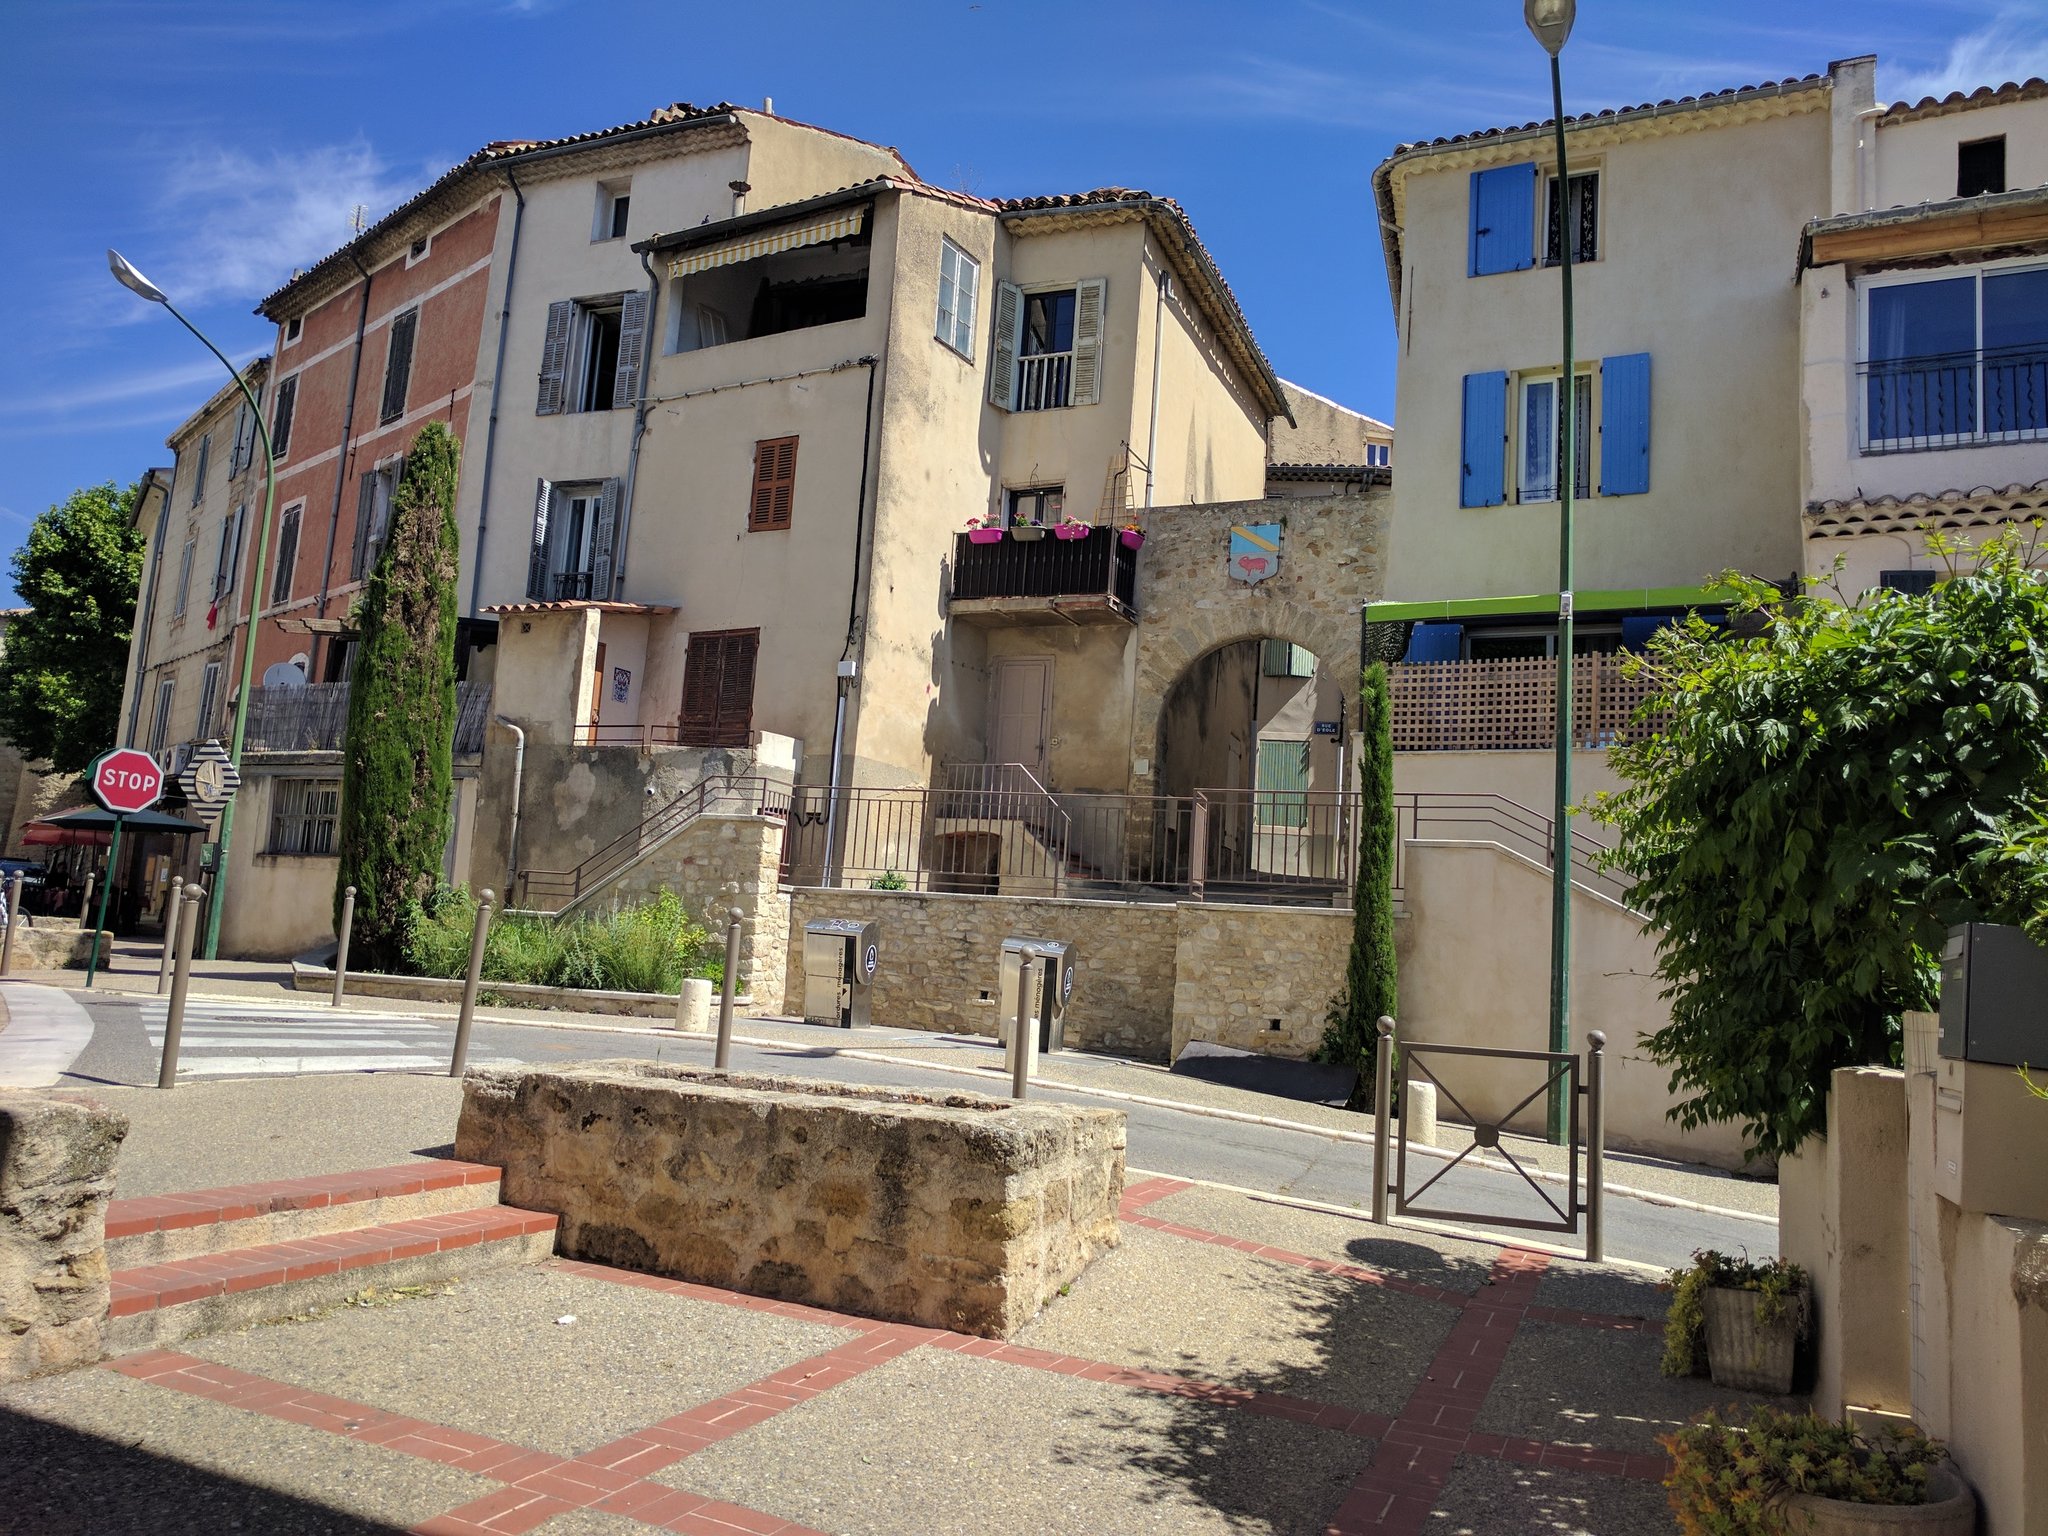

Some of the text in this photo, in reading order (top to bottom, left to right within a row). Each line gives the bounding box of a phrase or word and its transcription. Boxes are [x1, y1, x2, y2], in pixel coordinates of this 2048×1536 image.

[103, 768, 156, 792] STOP
[836, 947, 844, 988] ménagères
[1034, 967, 1043, 1009] ménagères
